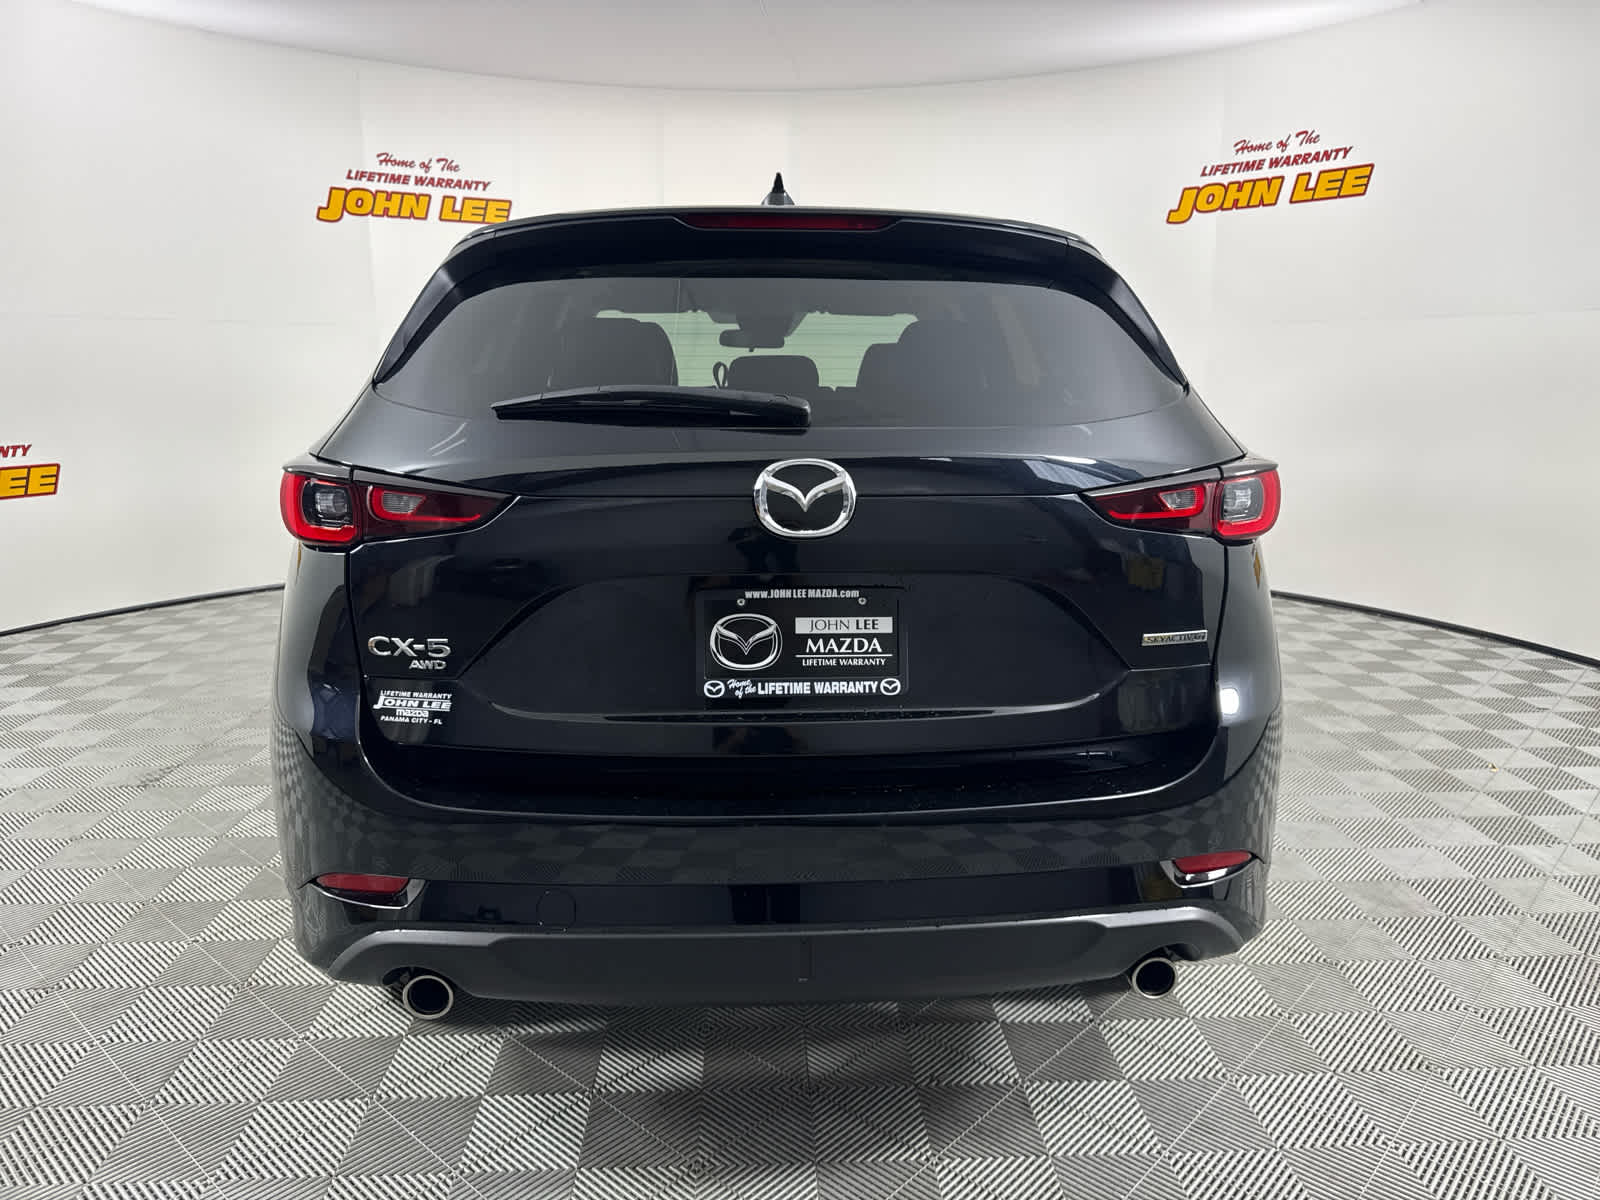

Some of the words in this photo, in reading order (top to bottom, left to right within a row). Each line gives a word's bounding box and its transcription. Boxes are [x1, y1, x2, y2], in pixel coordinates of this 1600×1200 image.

[1233, 139, 1273, 156] Home
[1276, 134, 1292, 153] of
[1295, 129, 1321, 147] The
[376, 152, 416, 169] Home
[419, 159, 433, 173] of
[436, 158, 461, 173] The
[1200, 159, 1266, 177] LIFETIME
[1268, 146, 1353, 169] WARRANTY
[346, 169, 411, 185] LIFETIME
[414, 175, 491, 191] WARRANTY
[1166, 176, 1284, 224] JOHN
[1289, 163, 1375, 204] LEE
[316, 187, 432, 222] JOHN
[439, 195, 512, 224] LEE
[0, 463, 61, 500] EE
[810, 619, 849, 633] JOHN
[855, 619, 879, 631] LEE
[367, 635, 451, 658] CX-5
[806, 638, 883, 653] MAZDA
[408, 660, 447, 670] AWD
[802, 658, 837, 666] LIFETIME
[839, 658, 886, 666] WARRANTY
[757, 682, 811, 695] LIFETIME
[814, 681, 878, 694] WARRANTY
[373, 695, 420, 709] JOHN
[422, 700, 452, 710] LEE
[380, 715, 410, 723] PANAMA
